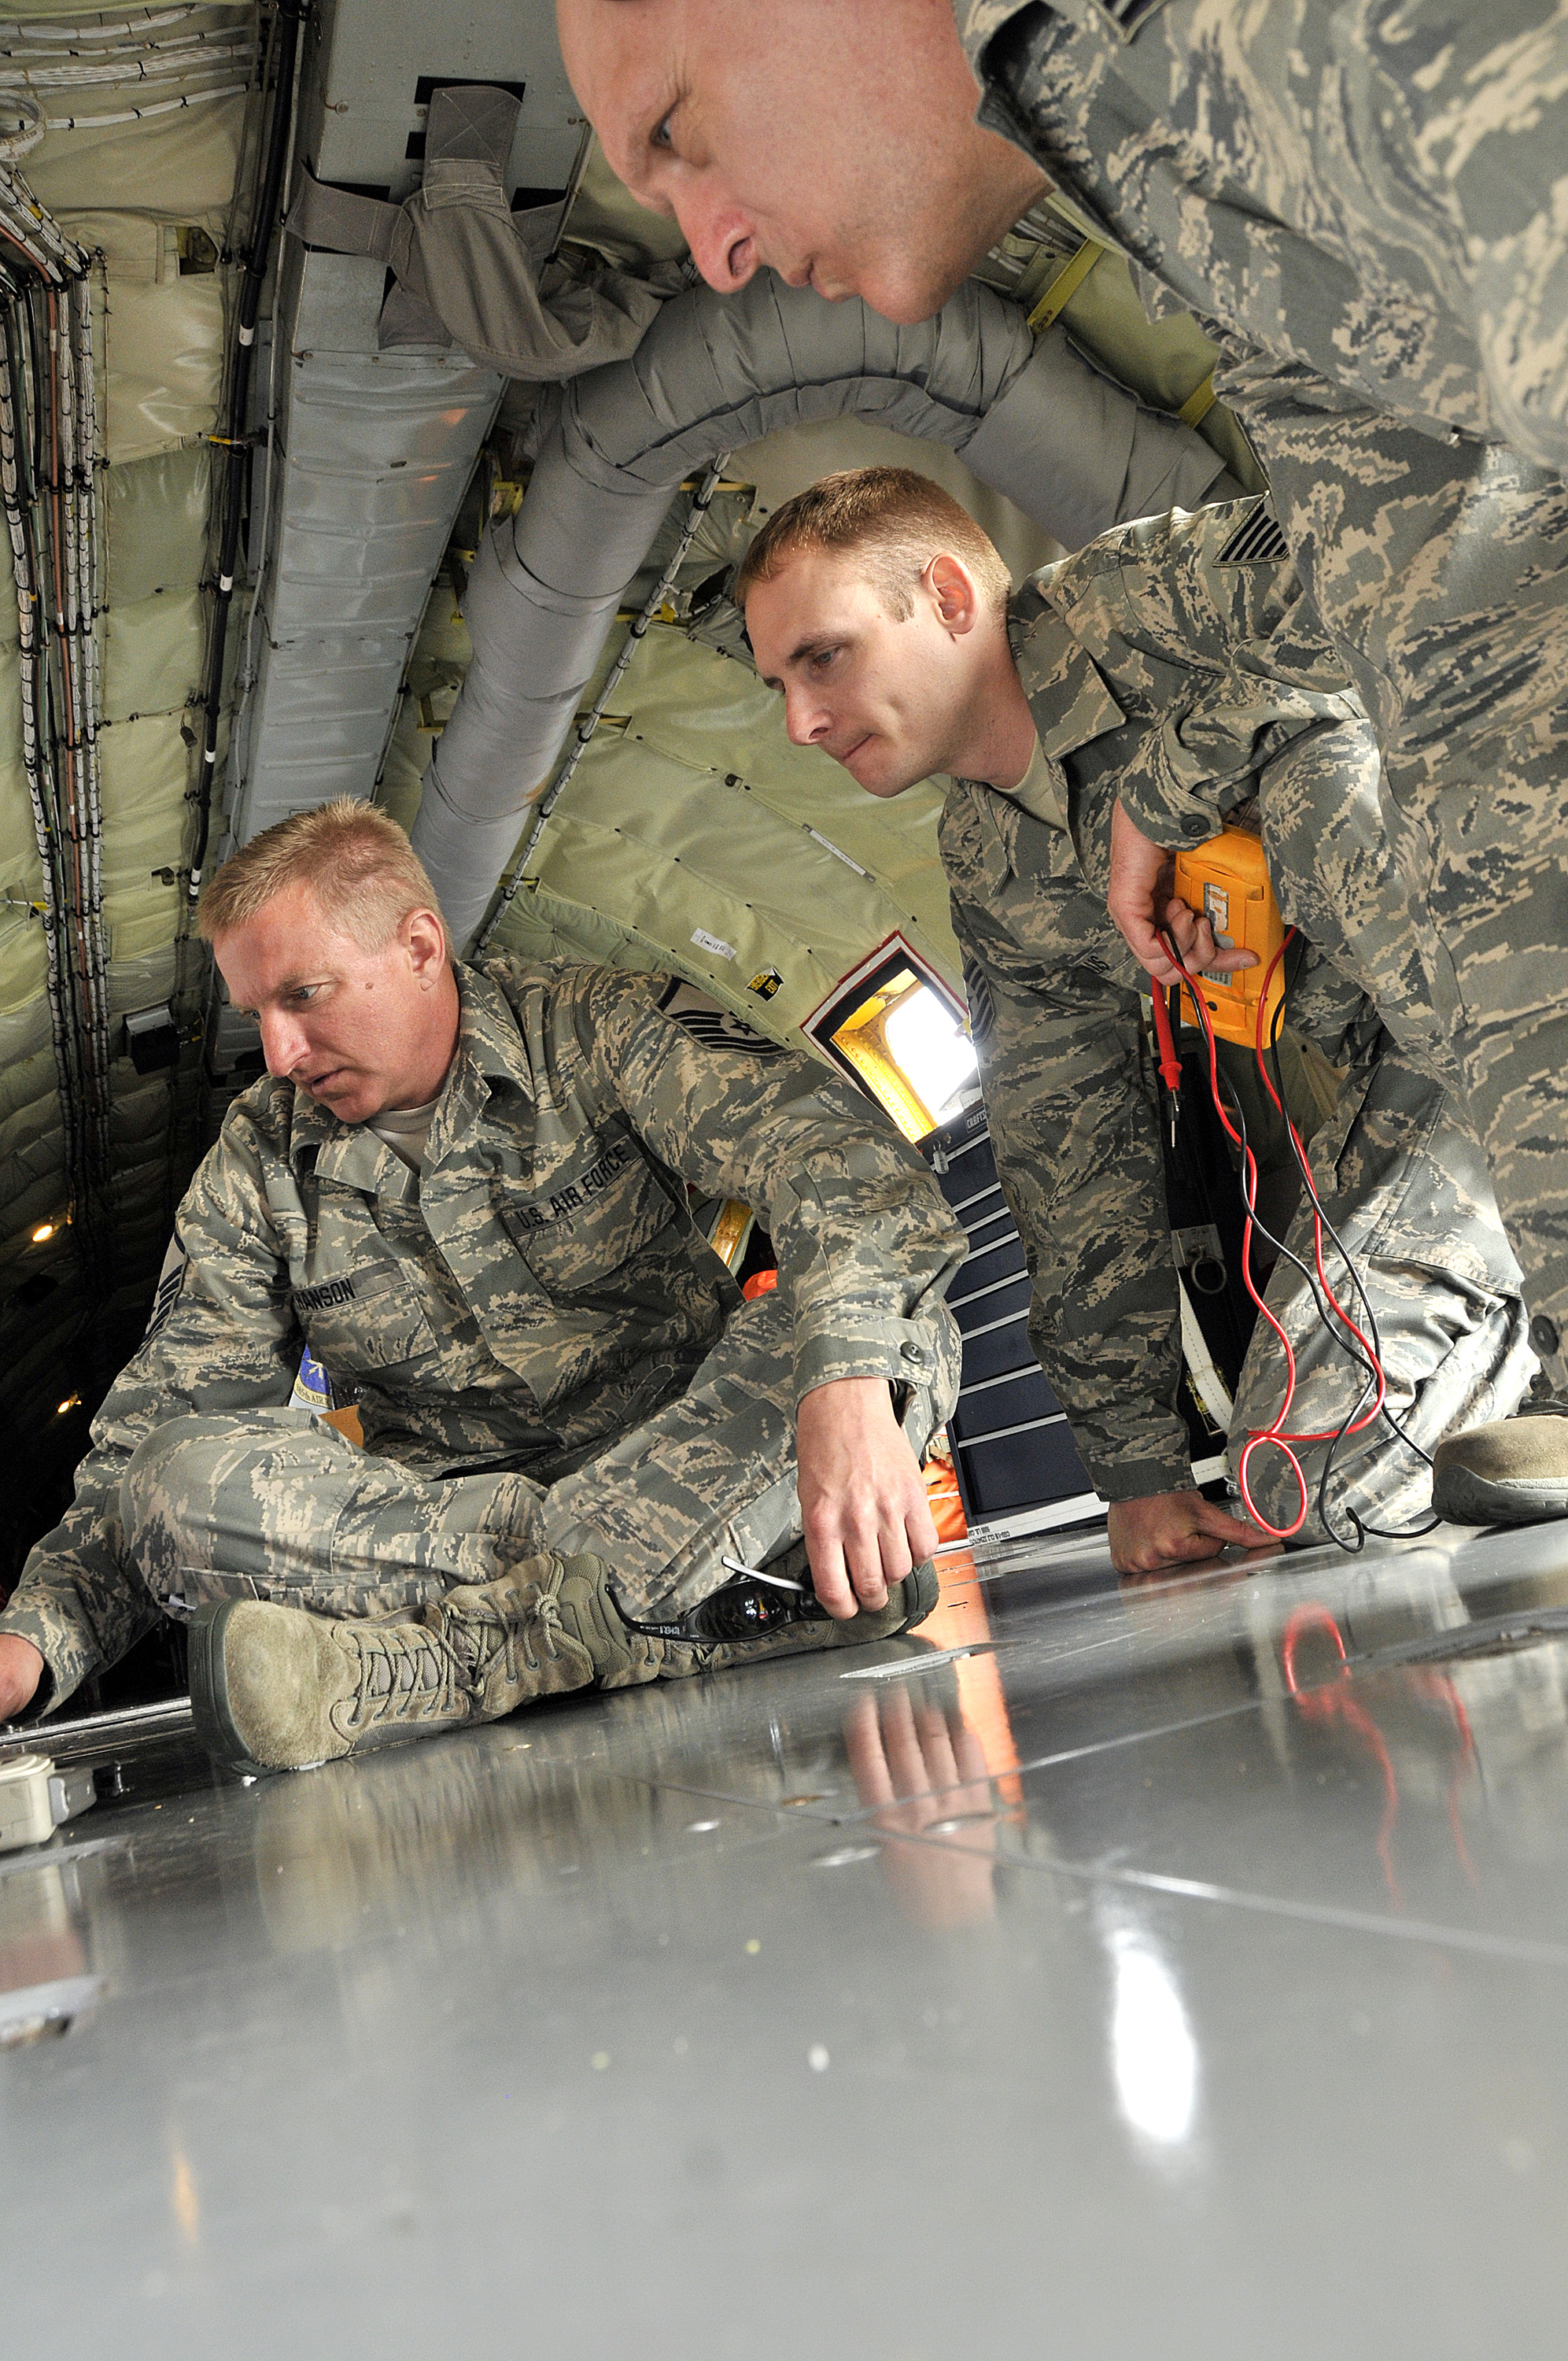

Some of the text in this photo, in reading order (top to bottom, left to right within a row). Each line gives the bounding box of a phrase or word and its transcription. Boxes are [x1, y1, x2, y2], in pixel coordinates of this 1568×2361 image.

[765, 979, 779, 994] EXIT
[515, 1144, 630, 1229] U.S. AIR FORCE
